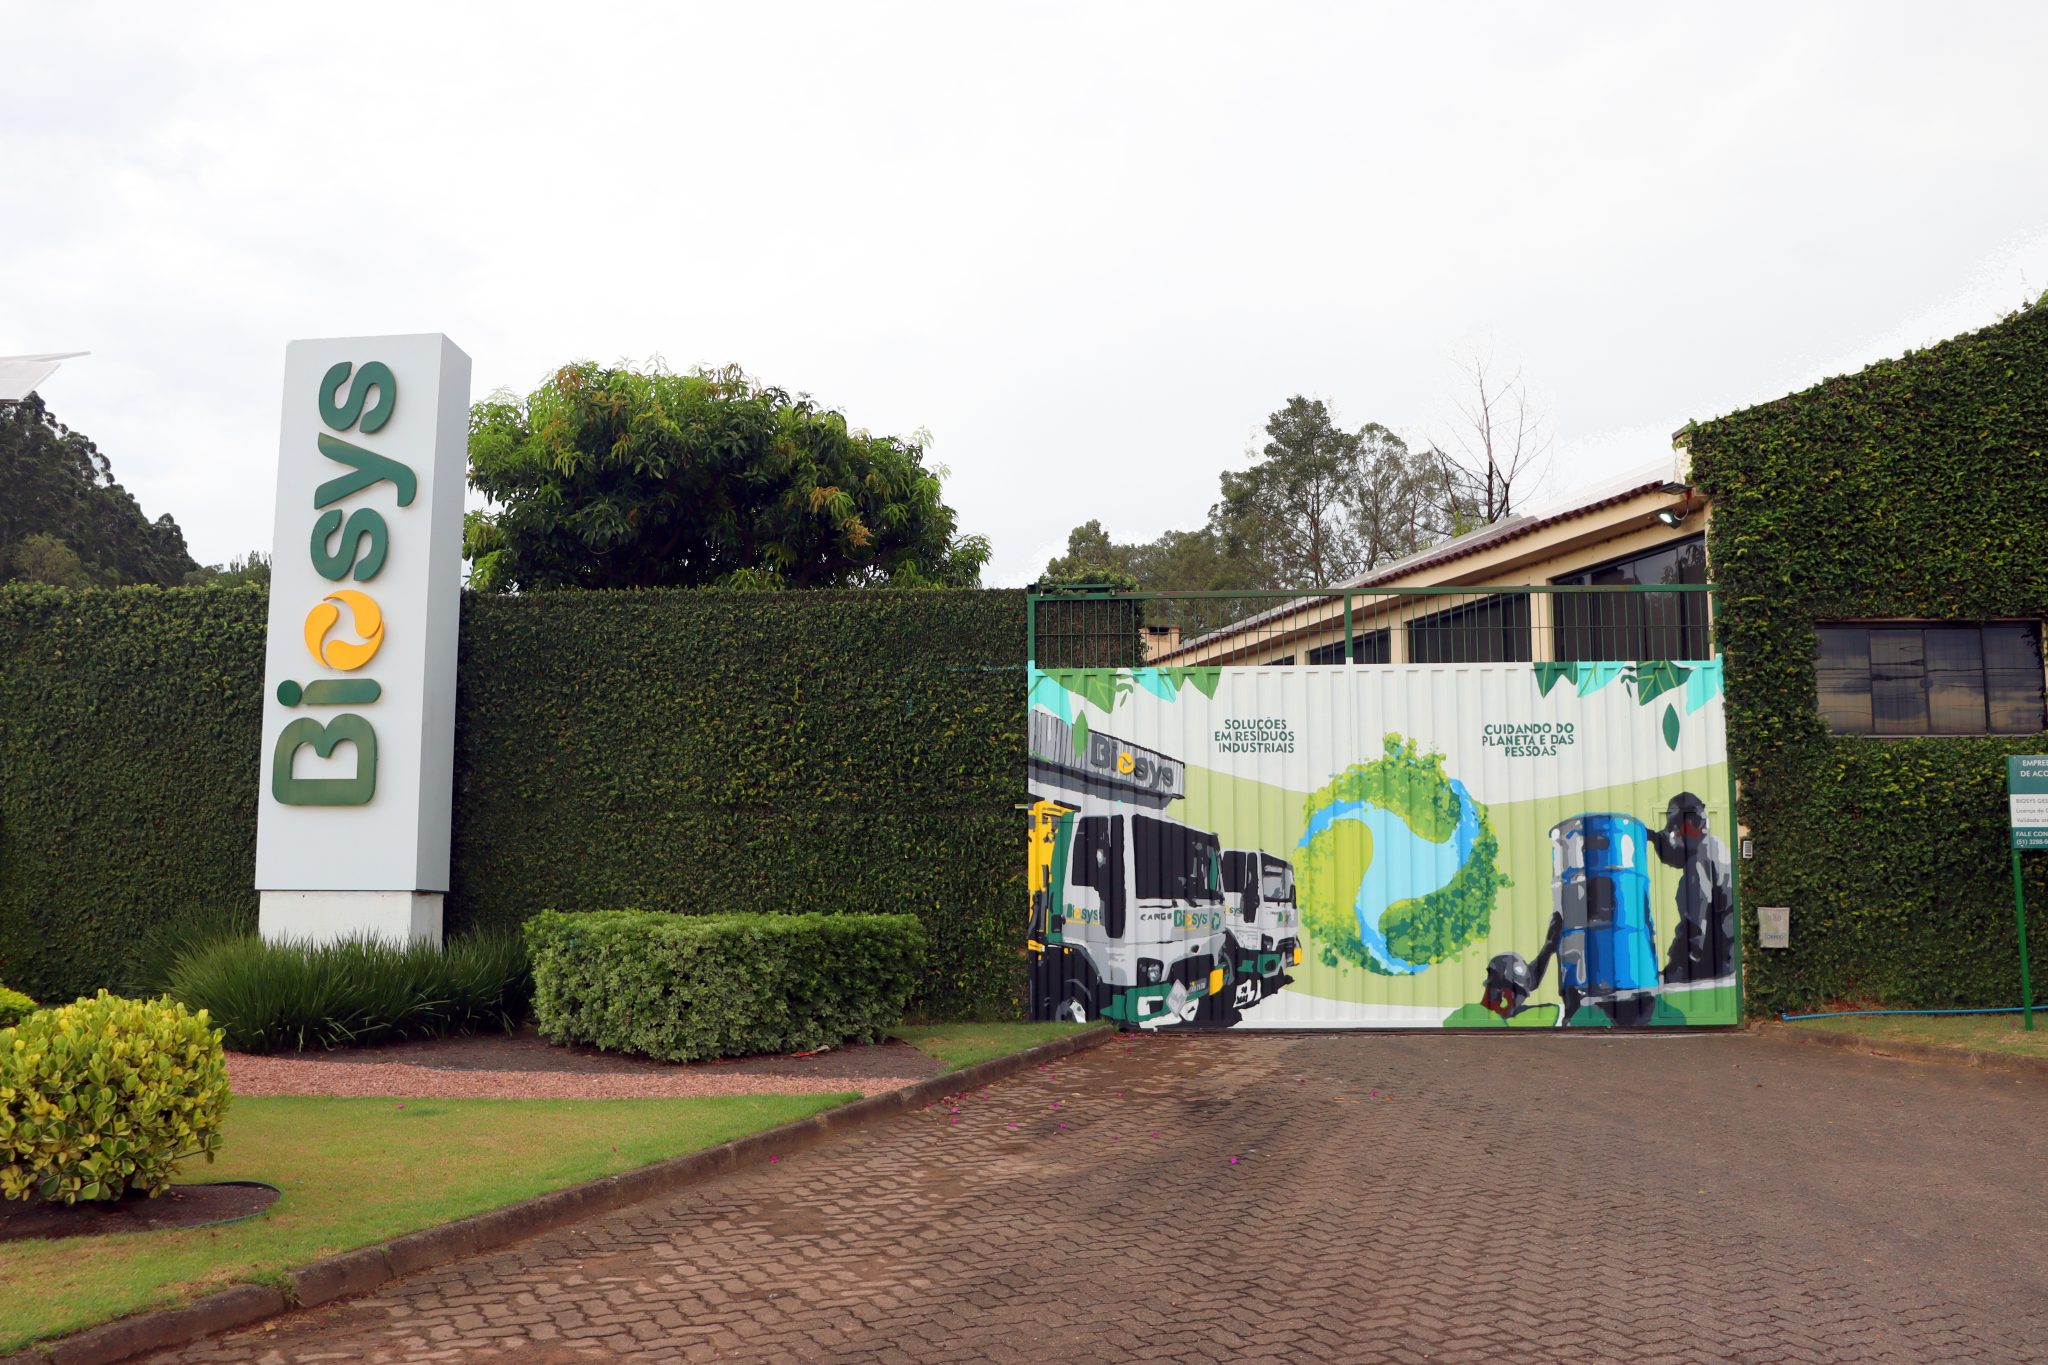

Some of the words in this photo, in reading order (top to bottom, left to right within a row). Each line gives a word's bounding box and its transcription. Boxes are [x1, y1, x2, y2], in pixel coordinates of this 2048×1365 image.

[272, 361, 417, 805] Biosys
[1224, 717, 1287, 731] SOLUÇÕES
[1484, 722, 1552, 735] CUIDANDO
[1556, 722, 1574, 734] DO
[1214, 730, 1232, 742] EM
[1482, 734, 1536, 747] PLANETA
[1540, 734, 1546, 745] E
[1550, 734, 1574, 745] DAS
[1218, 742, 1295, 753] INDUSTRIAIS
[1504, 745, 1557, 757] PESSOAS
[1090, 733, 1174, 790] Biosys
